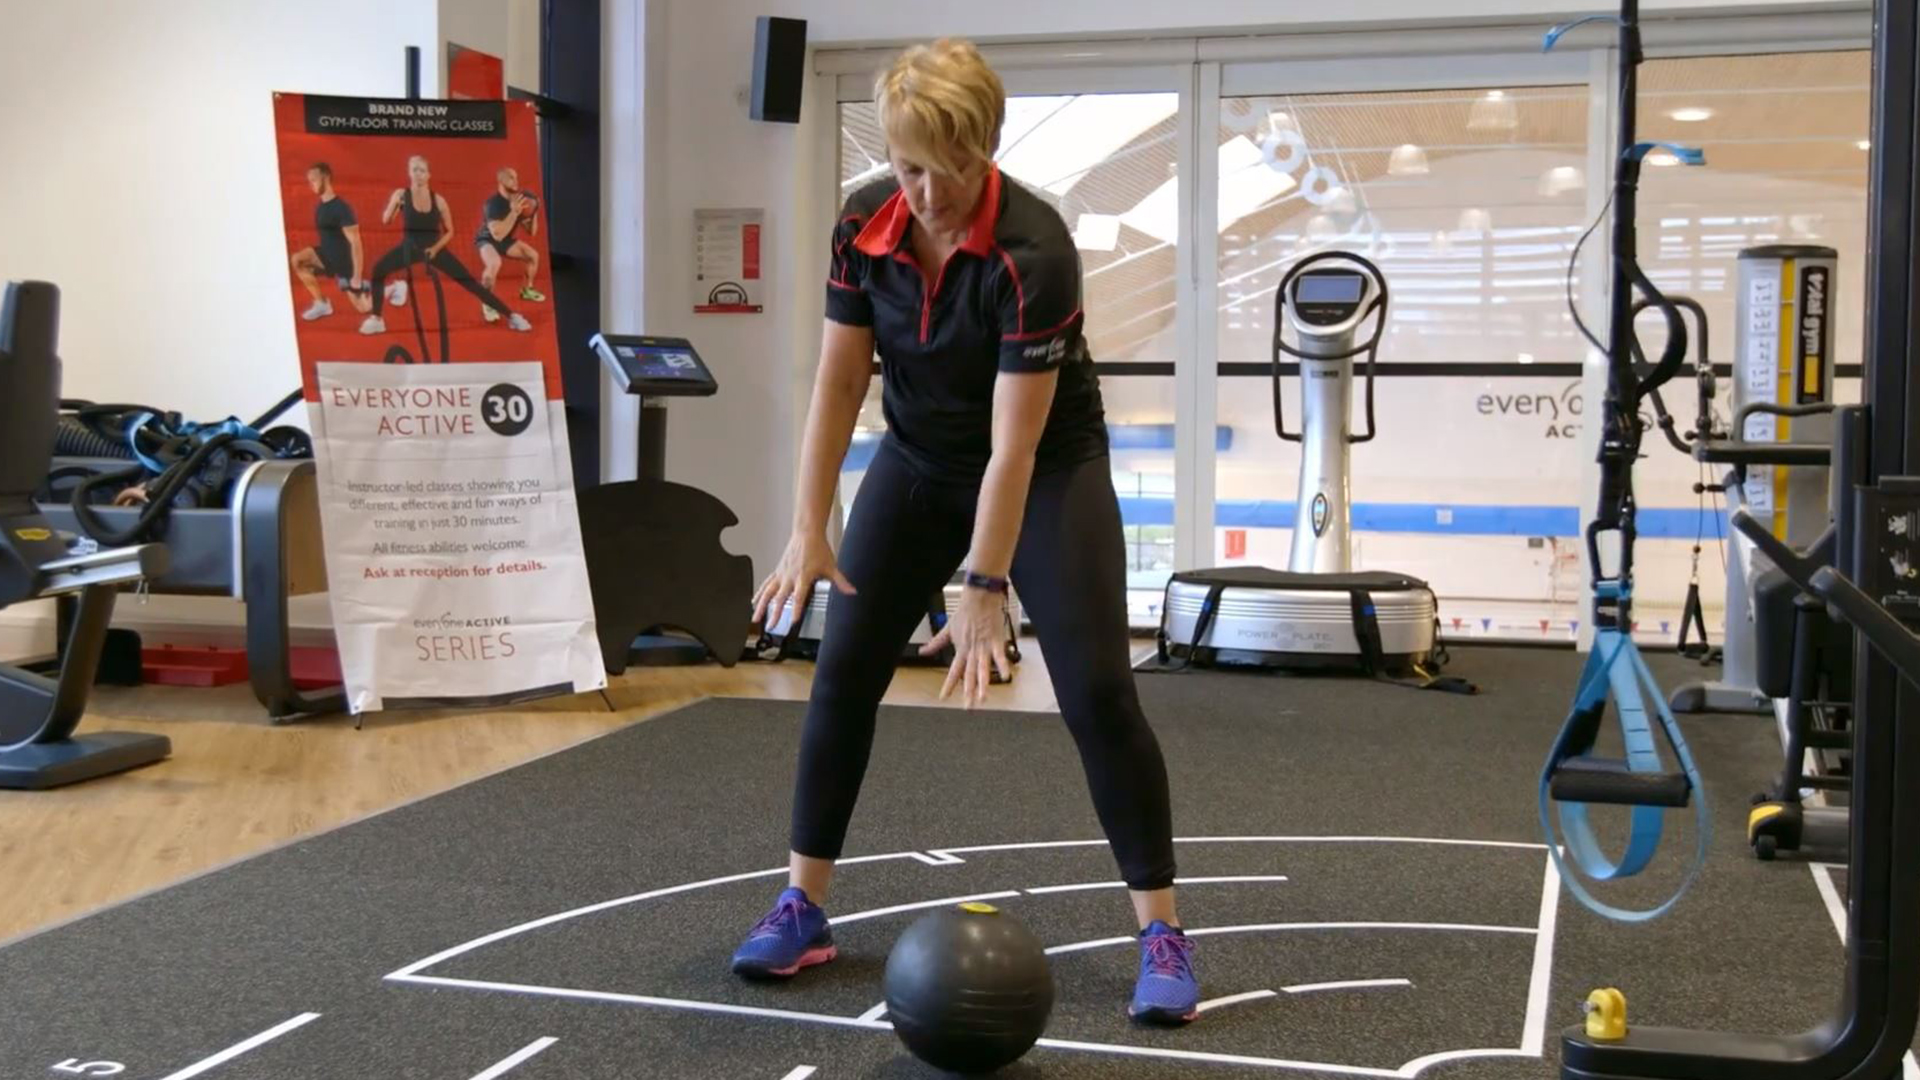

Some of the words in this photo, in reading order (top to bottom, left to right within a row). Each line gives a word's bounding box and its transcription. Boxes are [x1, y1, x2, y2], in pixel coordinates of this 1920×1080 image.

[368, 103, 414, 115] BRAND
[417, 105, 448, 116] NEW
[318, 116, 389, 128] GYM-FLOOR
[393, 119, 447, 130] TRAINING
[449, 120, 494, 131] CLASSES
[333, 387, 471, 408] EVERYONE
[488, 395, 528, 423] 30
[1476, 379, 1583, 420] everyo
[377, 415, 474, 436] ACTIVE
[426, 481, 464, 493] classes
[467, 480, 514, 493] showing
[518, 479, 540, 491] you
[401, 499, 448, 511] effective
[451, 498, 472, 510] and
[475, 497, 494, 508] fun
[498, 498, 526, 509] ways
[529, 494, 542, 505] of
[374, 518, 416, 531] training
[418, 518, 429, 528] in
[431, 517, 450, 530] just
[453, 516, 468, 527] 30
[470, 515, 521, 527] minutes.
[373, 542, 388, 554] All
[390, 543, 428, 554] fitness
[428, 541, 468, 553] abilities
[472, 539, 528, 551] welcome.
[363, 567, 388, 579] Ask
[393, 568, 406, 578] at
[410, 566, 469, 579] reception
[473, 565, 492, 577] for
[496, 560, 547, 574] details.
[465, 616, 511, 628] ACTIVE
[416, 632, 515, 661] SERIES
